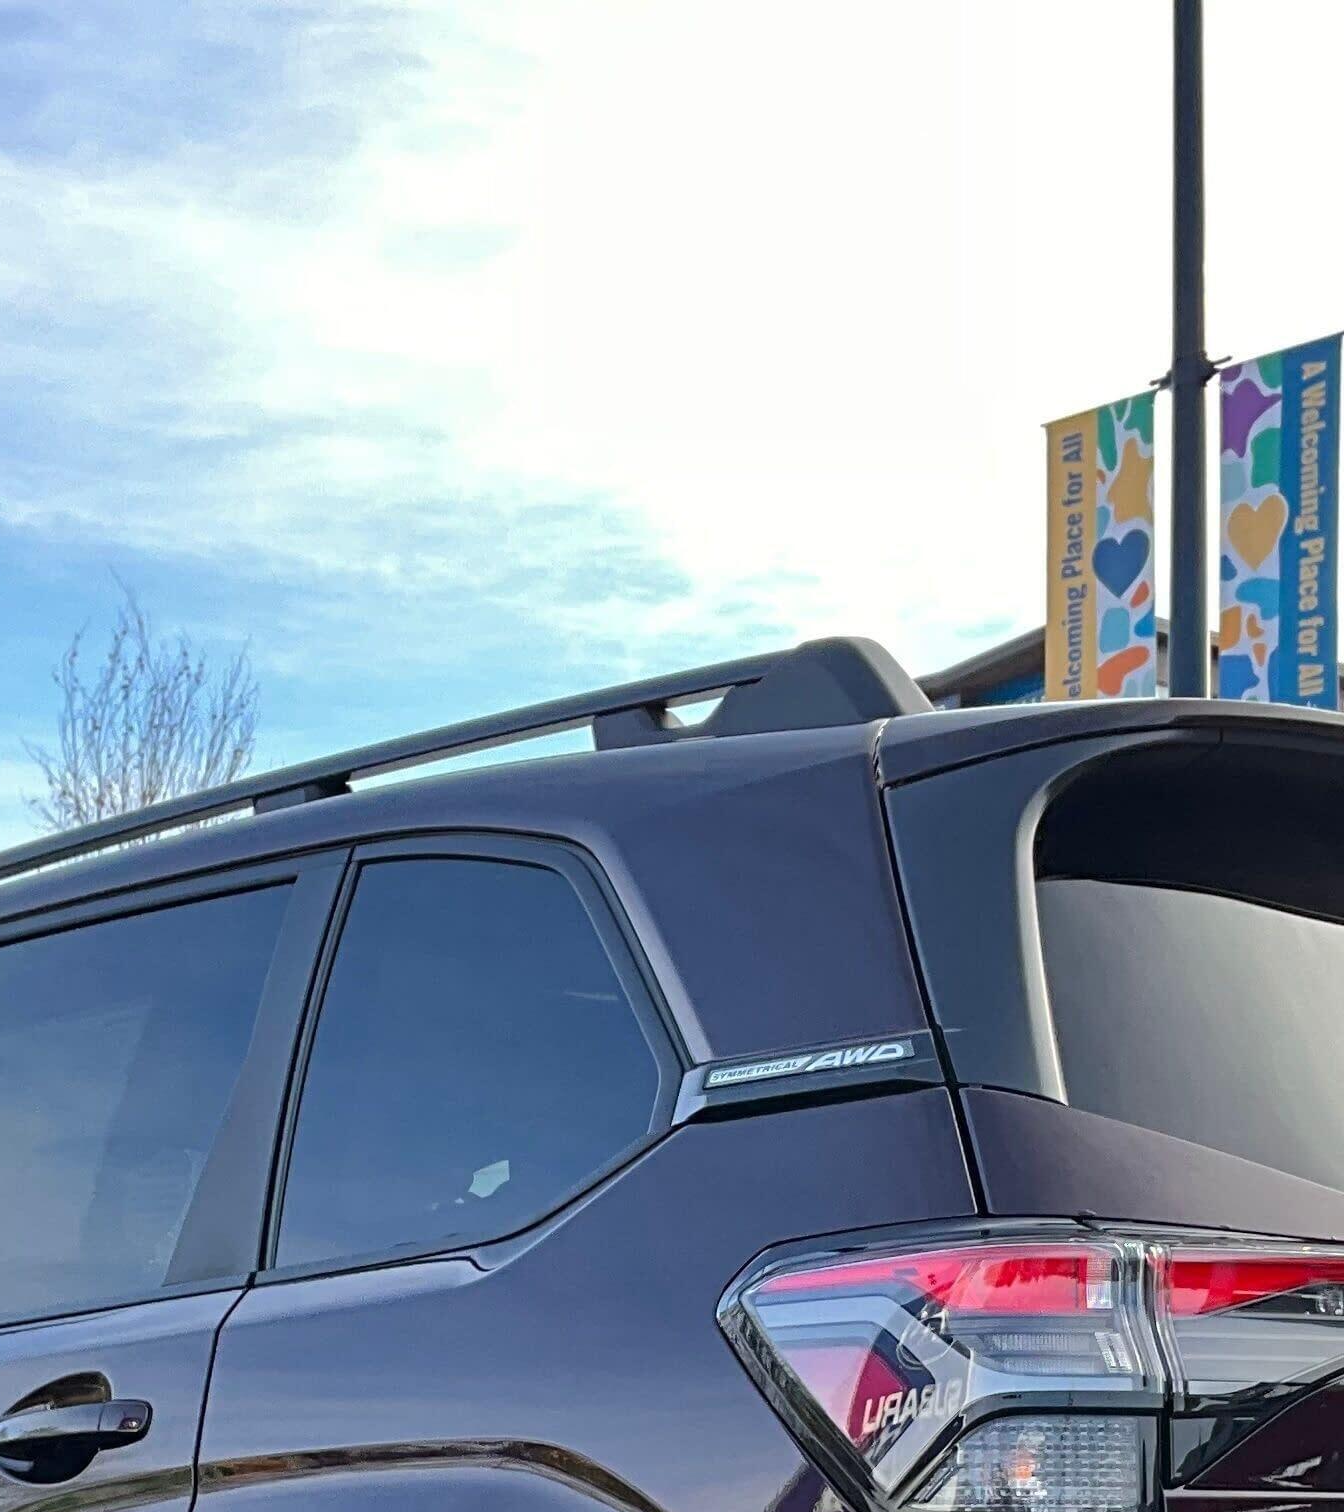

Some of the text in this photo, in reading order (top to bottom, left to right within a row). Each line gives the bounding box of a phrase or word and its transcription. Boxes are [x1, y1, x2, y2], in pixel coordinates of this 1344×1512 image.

[1061, 432, 1088, 698] elcoming Place for All
[1294, 361, 1327, 697] A Welcoming Place for All
[711, 1043, 905, 1082] SYMMETRICAL AWD
